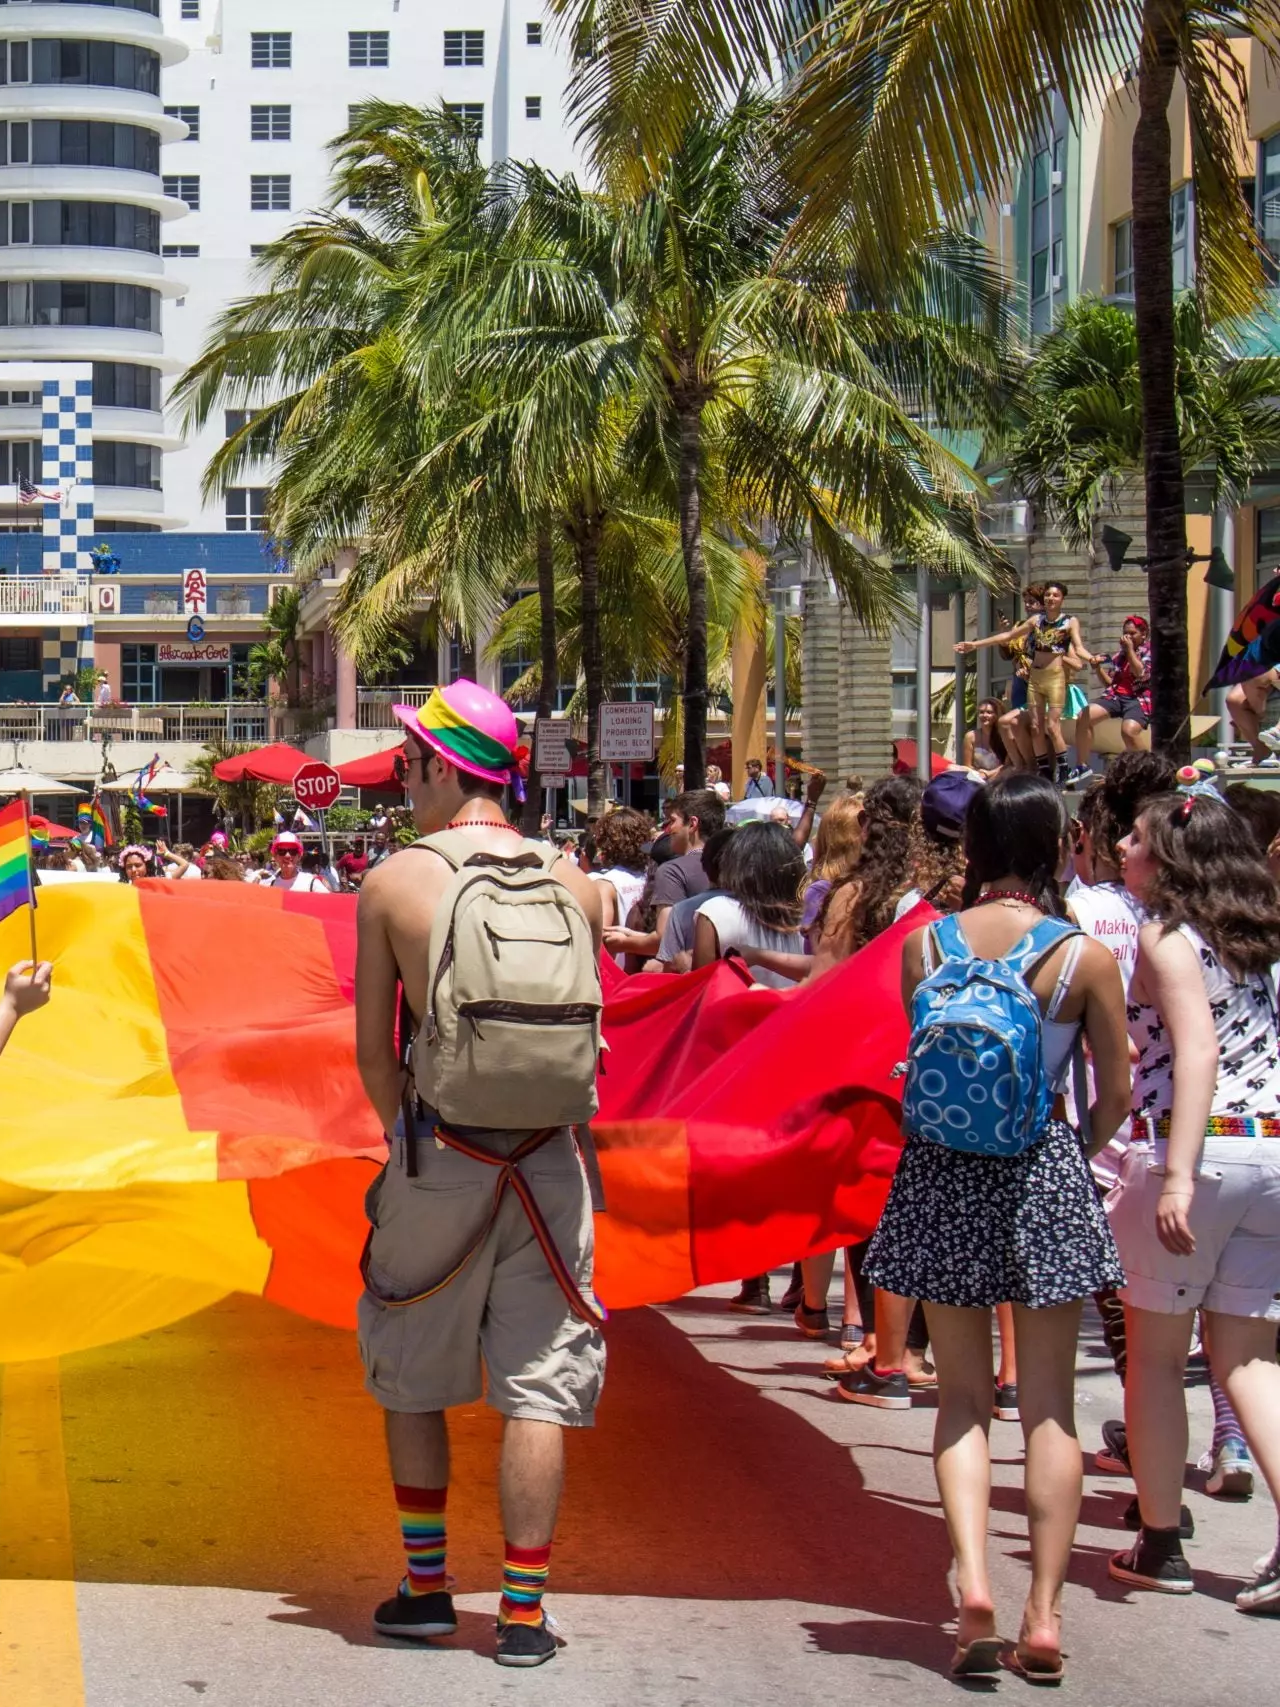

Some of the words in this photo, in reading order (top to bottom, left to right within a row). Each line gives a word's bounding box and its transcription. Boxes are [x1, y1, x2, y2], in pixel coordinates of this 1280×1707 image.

[185, 570, 206, 613] ART
[605, 706, 648, 714] COMMERCIAL
[611, 716, 642, 725] LOADING
[605, 727, 648, 736] PROHIBITED
[602, 739, 611, 747] ON
[615, 739, 628, 747] THIS
[631, 738, 650, 747] BLOCK
[297, 775, 337, 797] STOP
